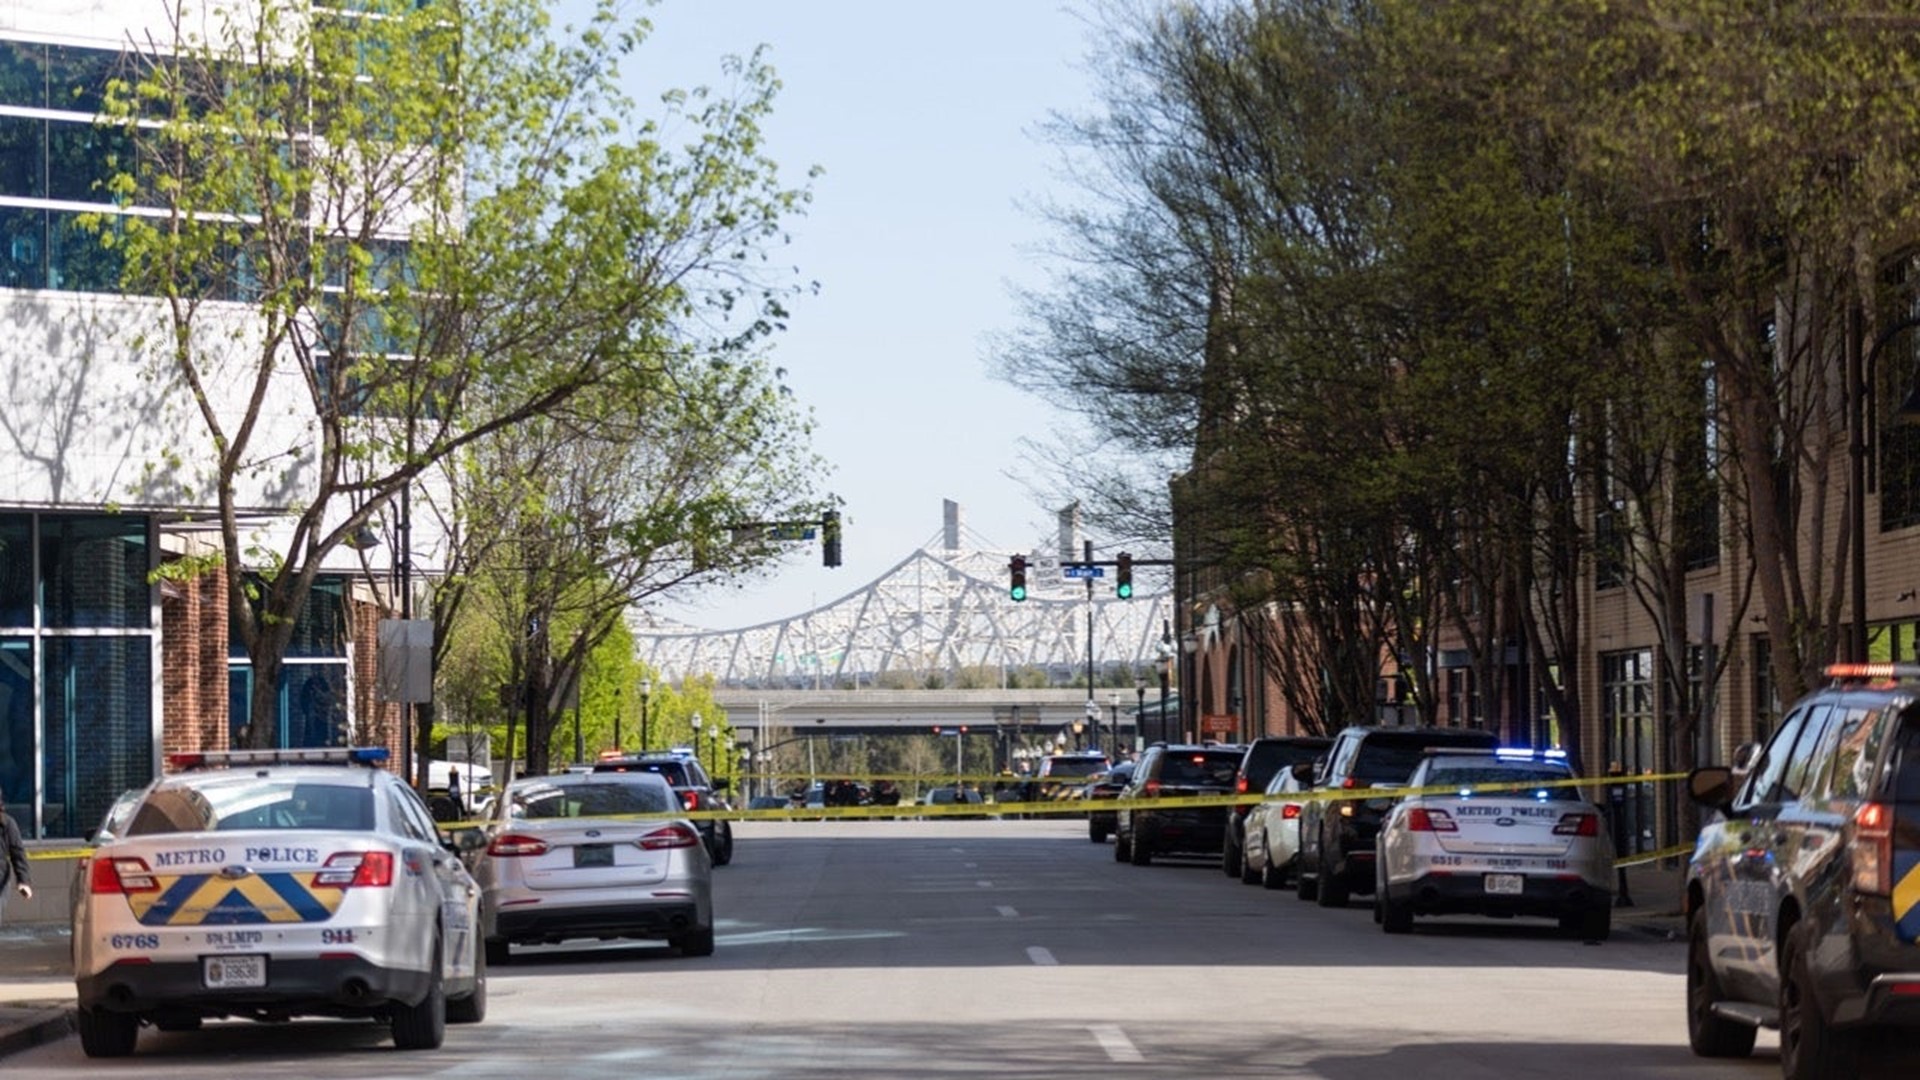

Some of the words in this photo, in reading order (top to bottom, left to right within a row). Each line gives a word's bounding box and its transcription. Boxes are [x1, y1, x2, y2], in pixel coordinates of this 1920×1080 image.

[1456, 806, 1501, 816] METRO
[1511, 806, 1557, 818] POLICE
[155, 848, 226, 867] METRO
[245, 847, 318, 863] POLICE
[111, 934, 159, 949] 6768
[322, 929, 356, 944] 911
